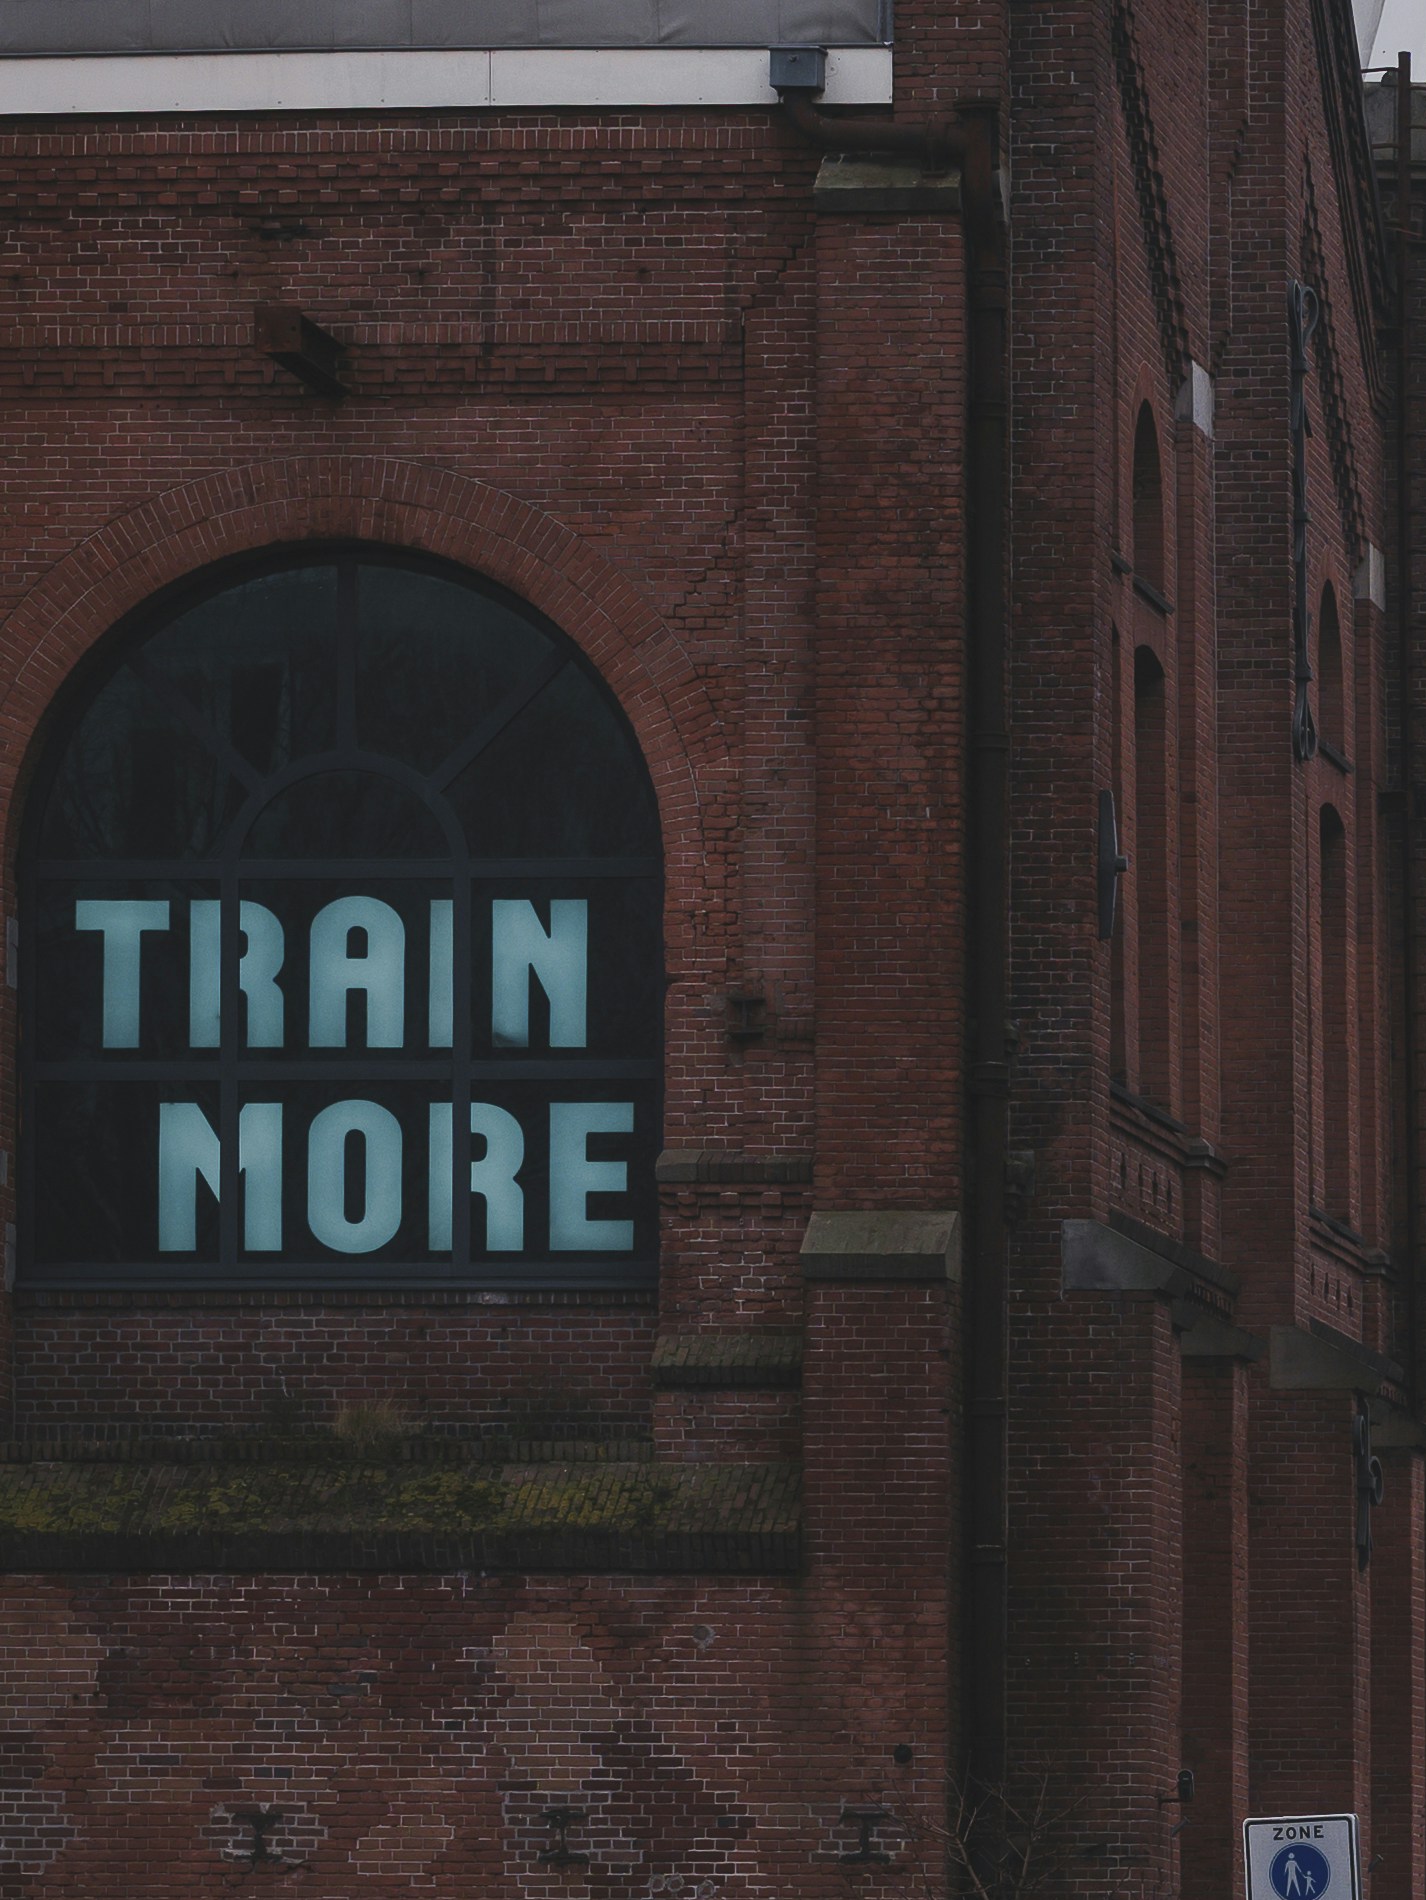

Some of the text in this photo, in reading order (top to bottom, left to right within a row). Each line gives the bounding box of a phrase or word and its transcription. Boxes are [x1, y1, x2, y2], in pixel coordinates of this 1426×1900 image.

[75, 895, 588, 1048] TRAIN
[158, 1099, 635, 1254] MORE
[1273, 1825, 1325, 1841] ZONE
